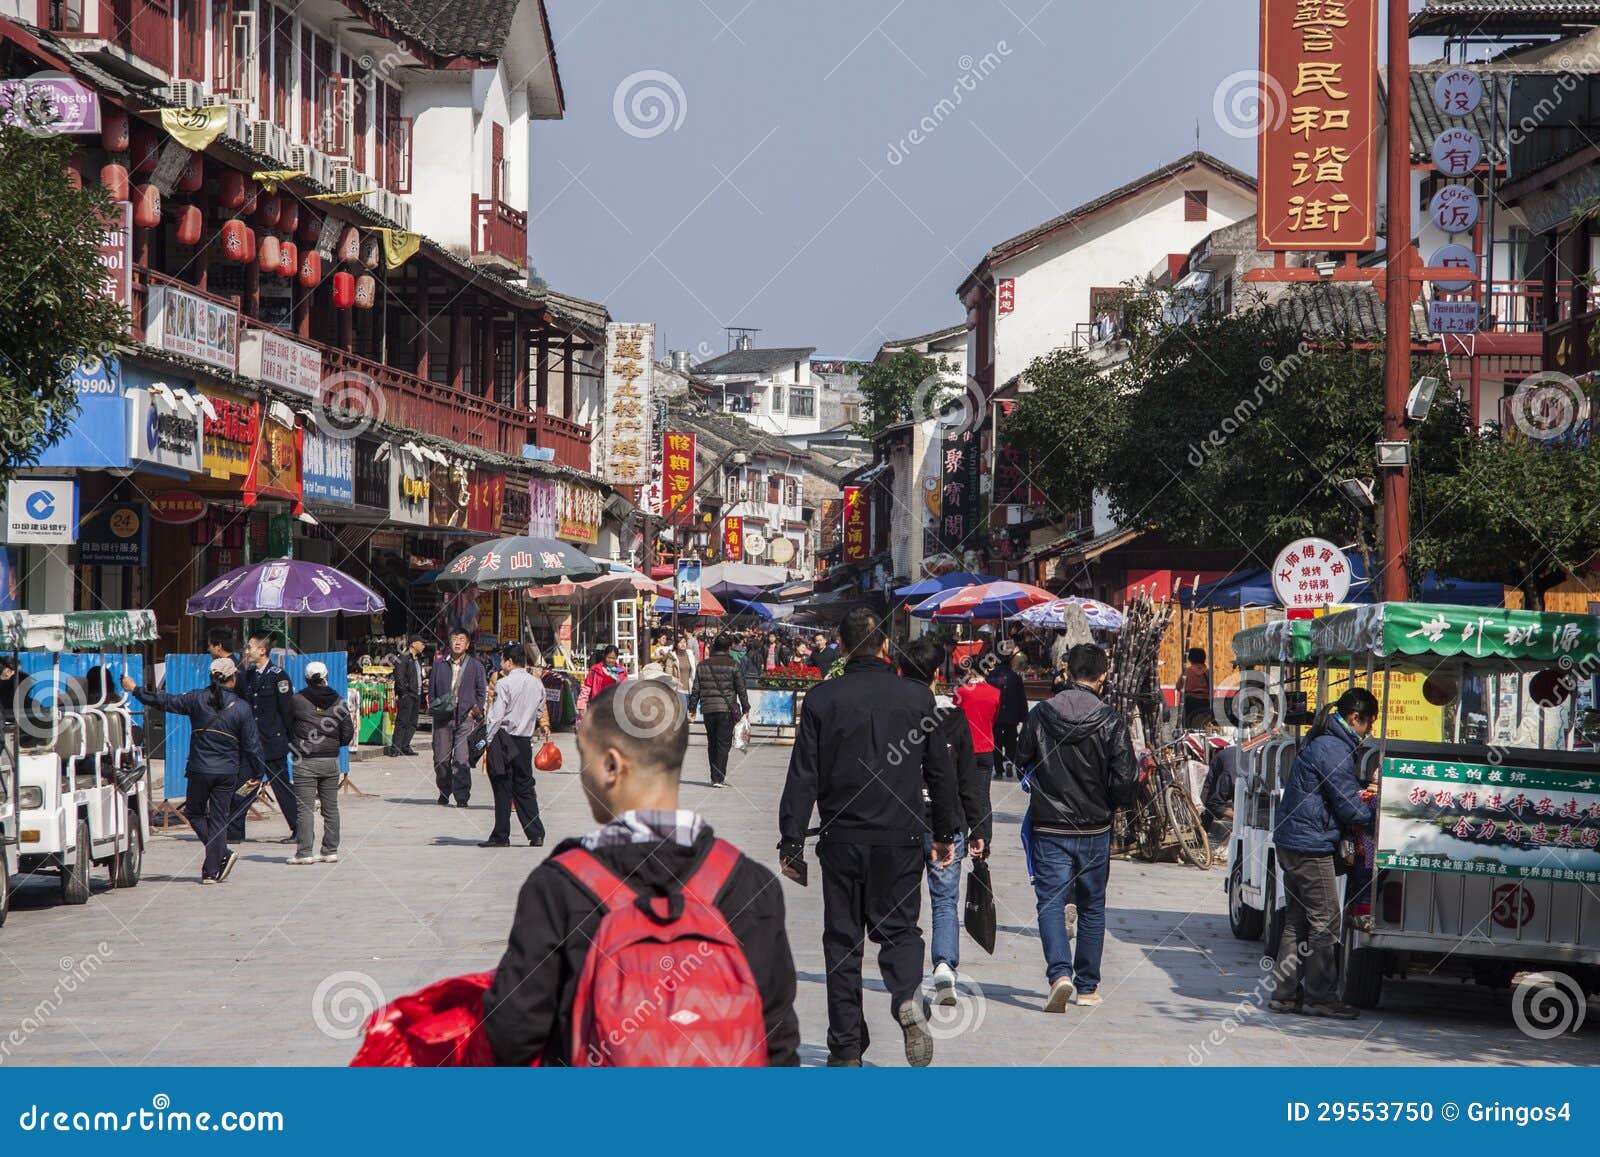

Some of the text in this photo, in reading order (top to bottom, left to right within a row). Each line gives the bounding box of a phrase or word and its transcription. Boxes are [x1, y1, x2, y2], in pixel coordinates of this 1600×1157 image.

[1444, 89, 1470, 111] 没
[1441, 132, 1472, 145] you
[1440, 149, 1472, 172] 有
[1437, 202, 1470, 227] 饭
[11, 523, 67, 532] 中国建设银行
[113, 515, 131, 528] 24
[1301, 565, 1321, 577] 烧烤
[1293, 591, 1334, 605] 桂林米粉
[1519, 866, 1600, 883] 世界旅游组织推
